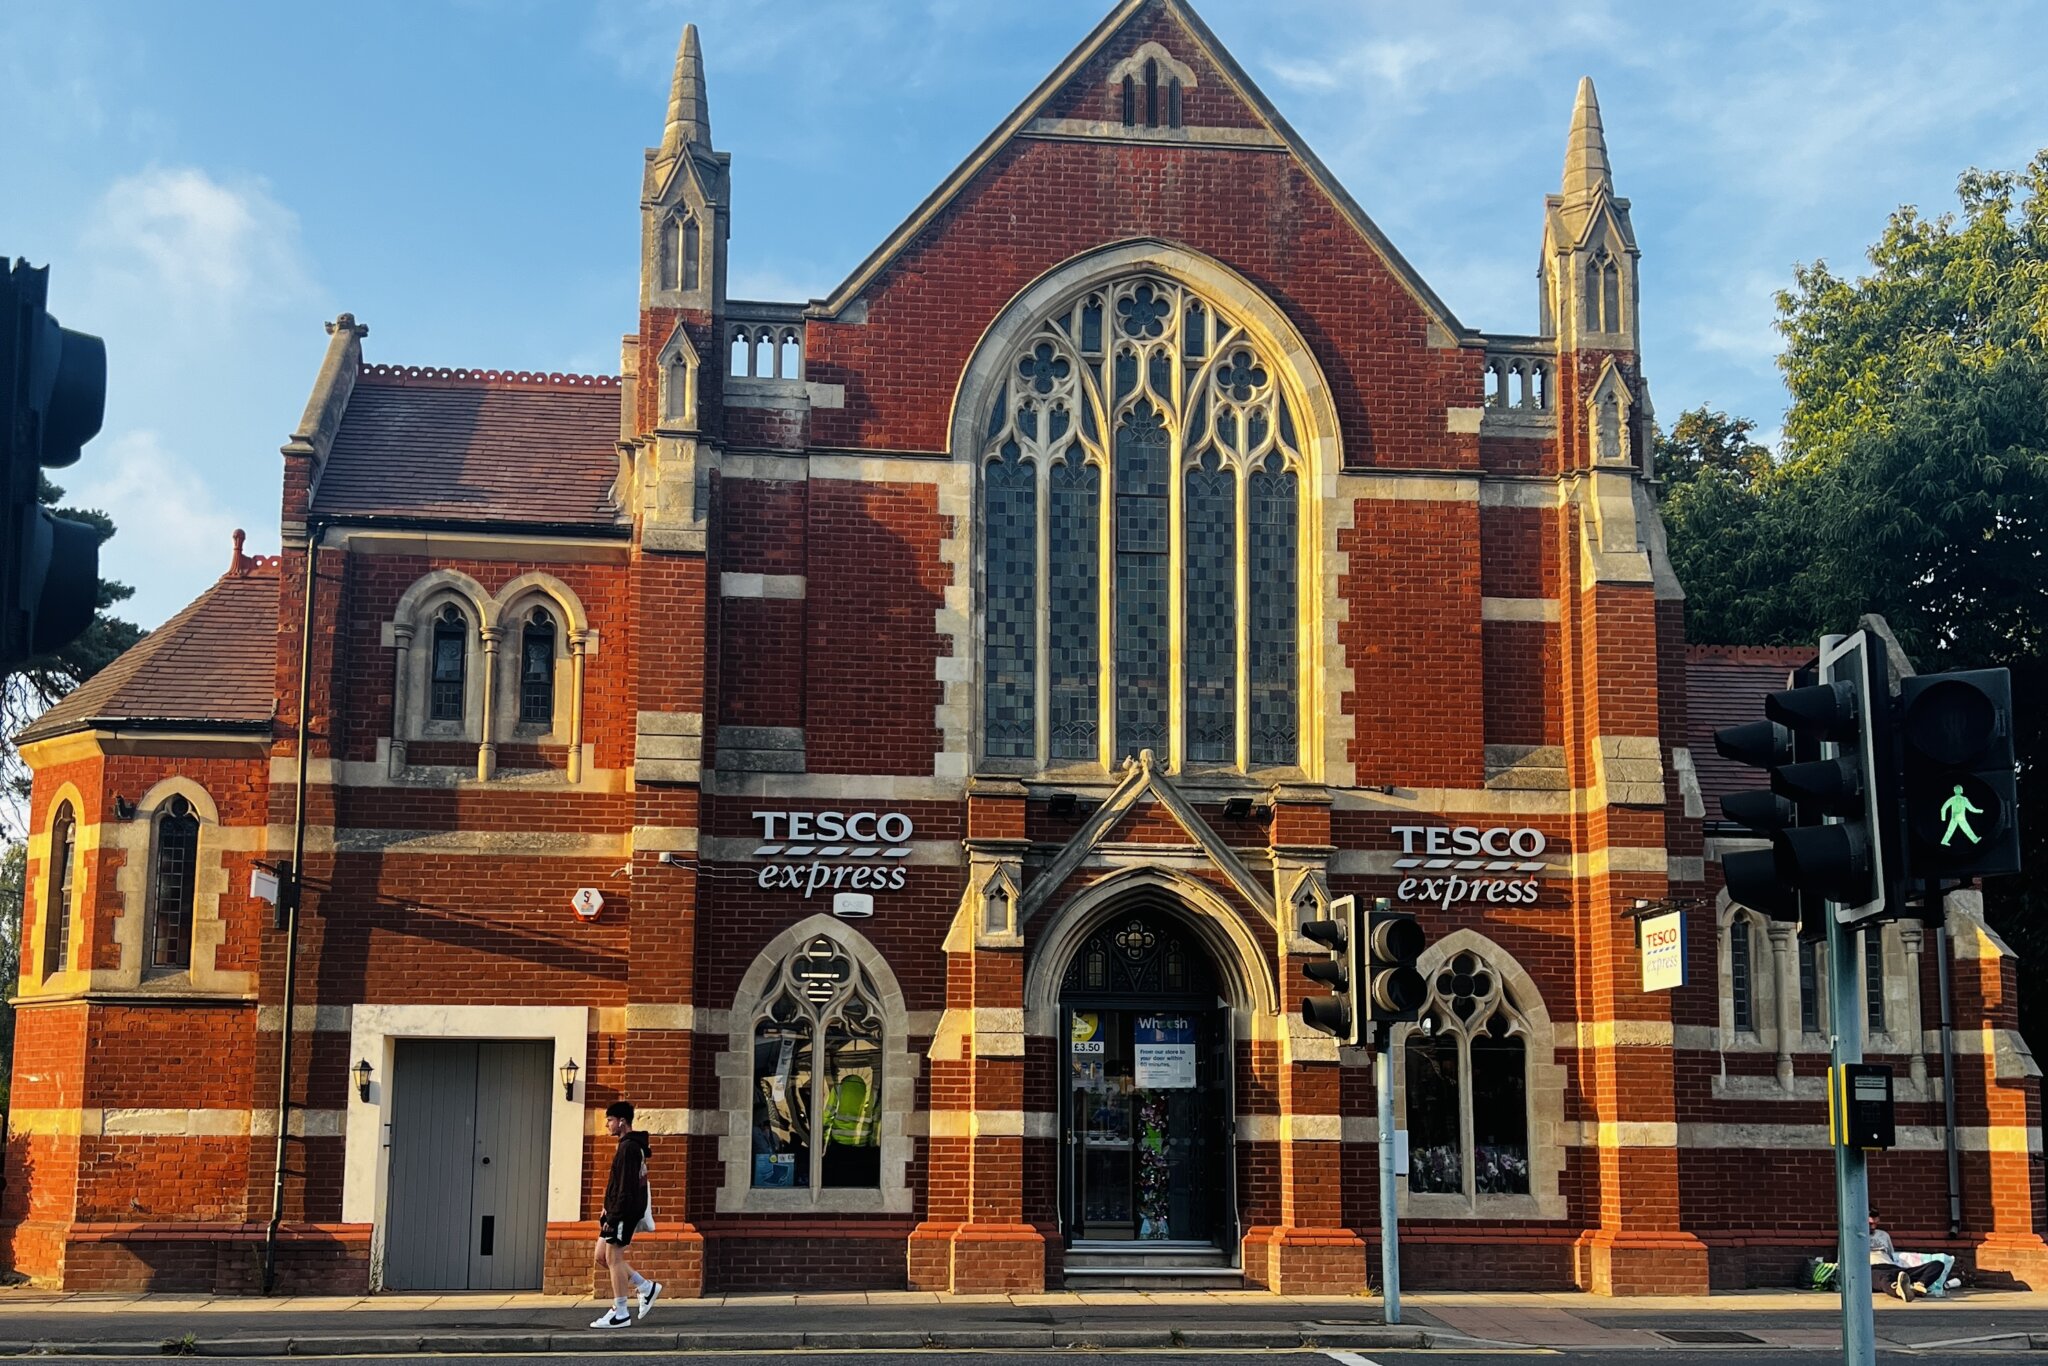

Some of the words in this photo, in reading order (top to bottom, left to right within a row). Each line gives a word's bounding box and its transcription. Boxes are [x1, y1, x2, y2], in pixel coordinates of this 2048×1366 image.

[752, 811, 914, 843] TESCO
[1391, 826, 1546, 858] TESCO
[758, 860, 907, 899] express
[1397, 874, 1539, 911] express
[1646, 928, 1677, 948] TESCO
[1646, 954, 1678, 977] express
[1074, 1042, 1100, 1052] £3.50
